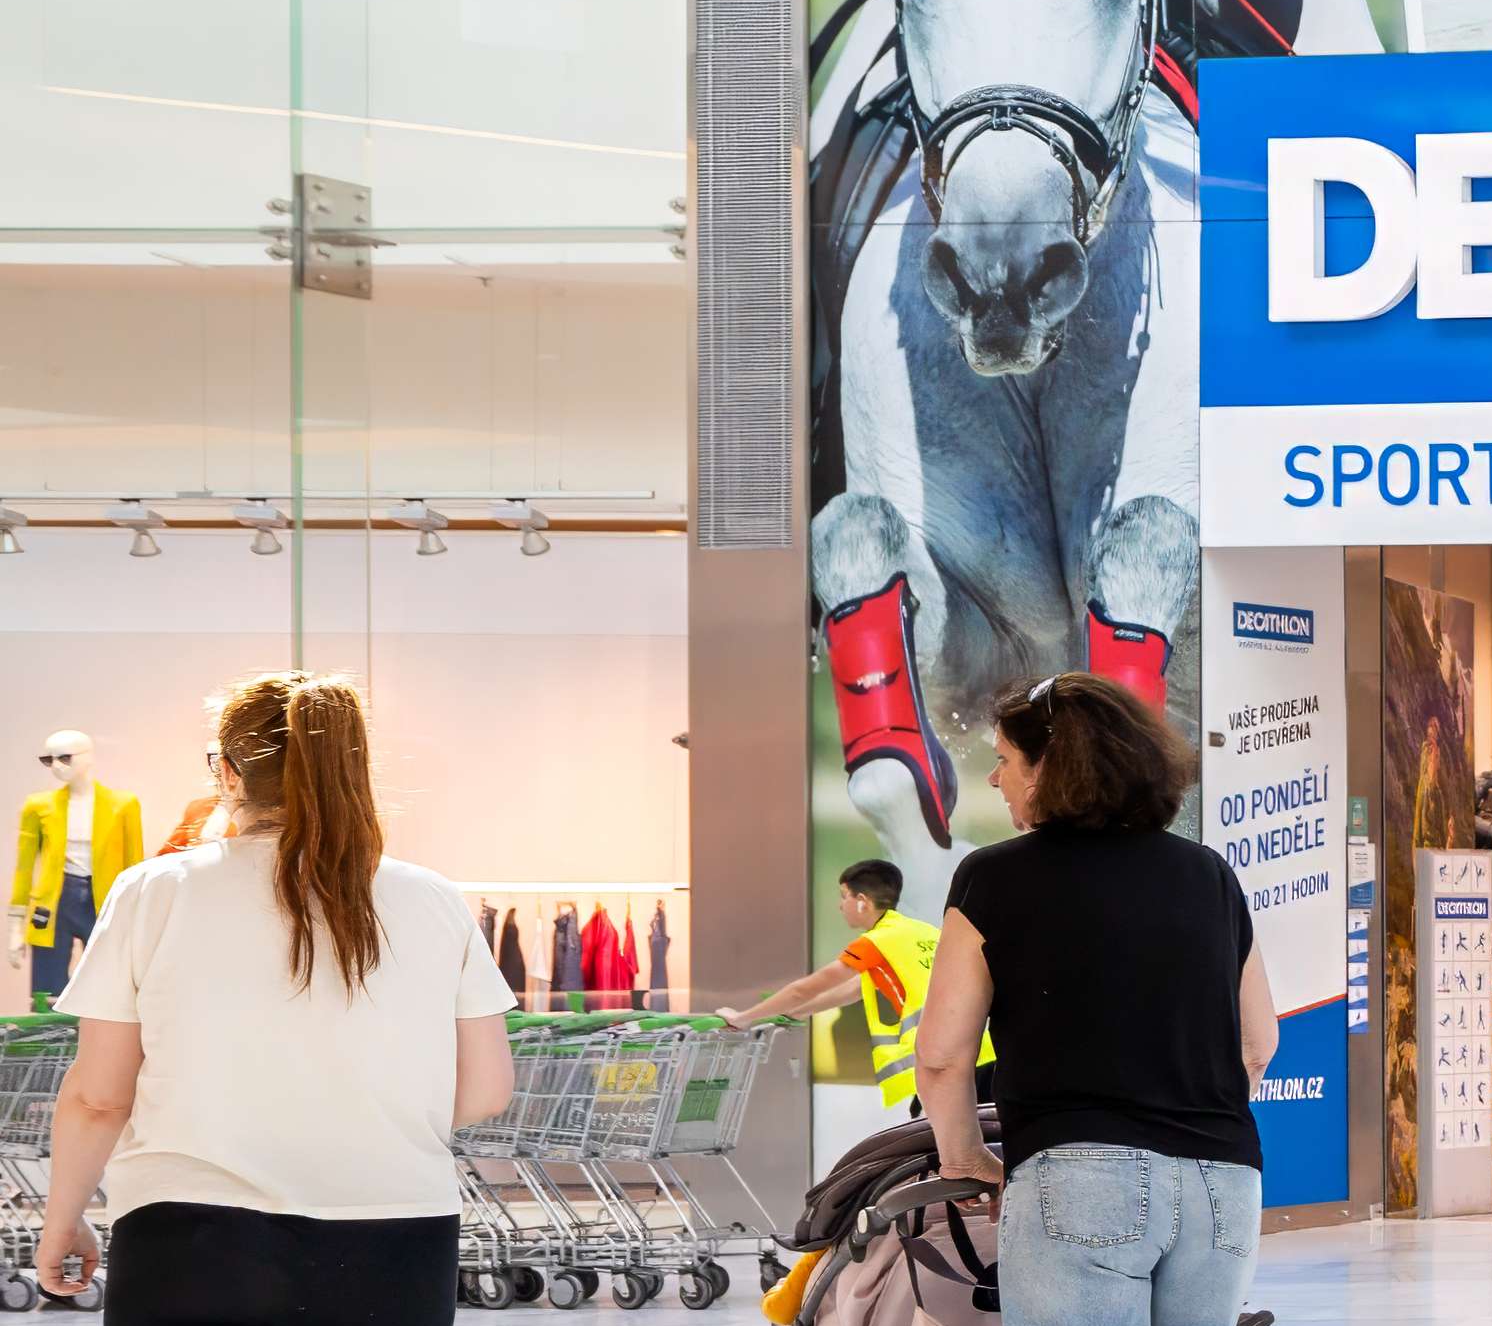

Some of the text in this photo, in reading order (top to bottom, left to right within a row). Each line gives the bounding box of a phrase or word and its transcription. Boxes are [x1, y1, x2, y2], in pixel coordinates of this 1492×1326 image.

[1236, 609, 1310, 637] DECATHLON
[1229, 695, 1320, 731] VAŠE PRODEJNA
[1237, 721, 1312, 755] JE OTEVŘENA
[1220, 764, 1329, 827] OD PONDĚLÍ
[1226, 815, 1325, 868] DO NEDĚLE
[1253, 889, 1270, 911] DO
[1274, 884, 1287, 905] 21
[1291, 871, 1329, 901] HODIN
